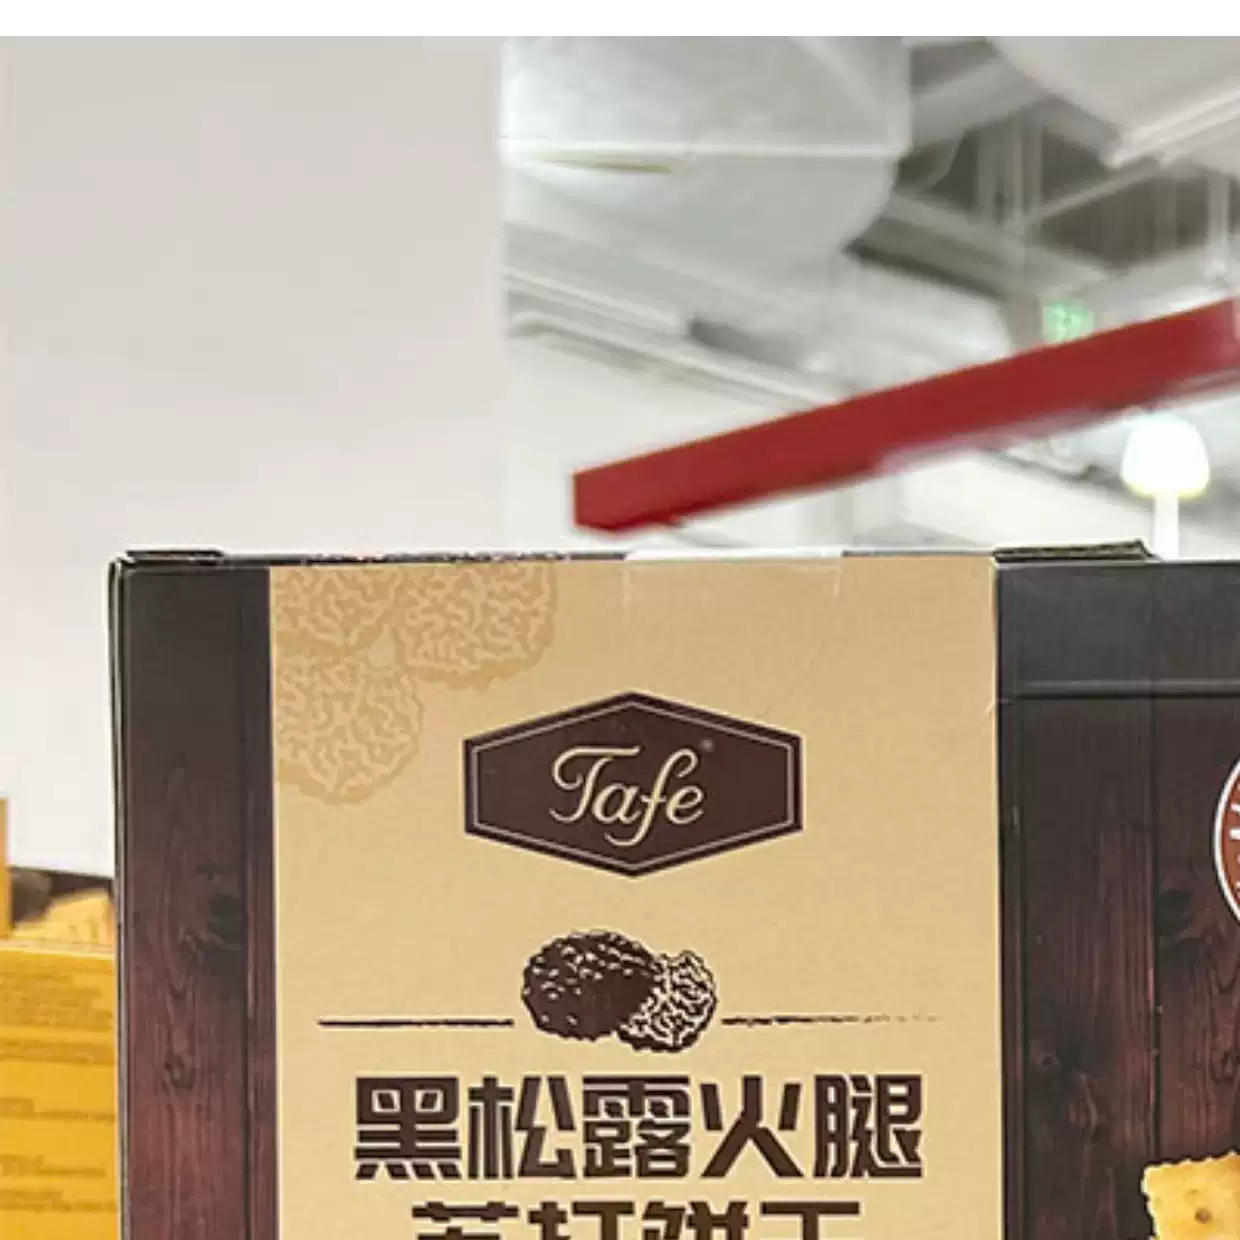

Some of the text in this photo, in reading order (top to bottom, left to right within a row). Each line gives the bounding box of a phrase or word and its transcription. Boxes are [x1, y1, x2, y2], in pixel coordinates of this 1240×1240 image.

[549, 744, 704, 846] Tafe
[355, 1074, 923, 1180] 黑松露火腿
